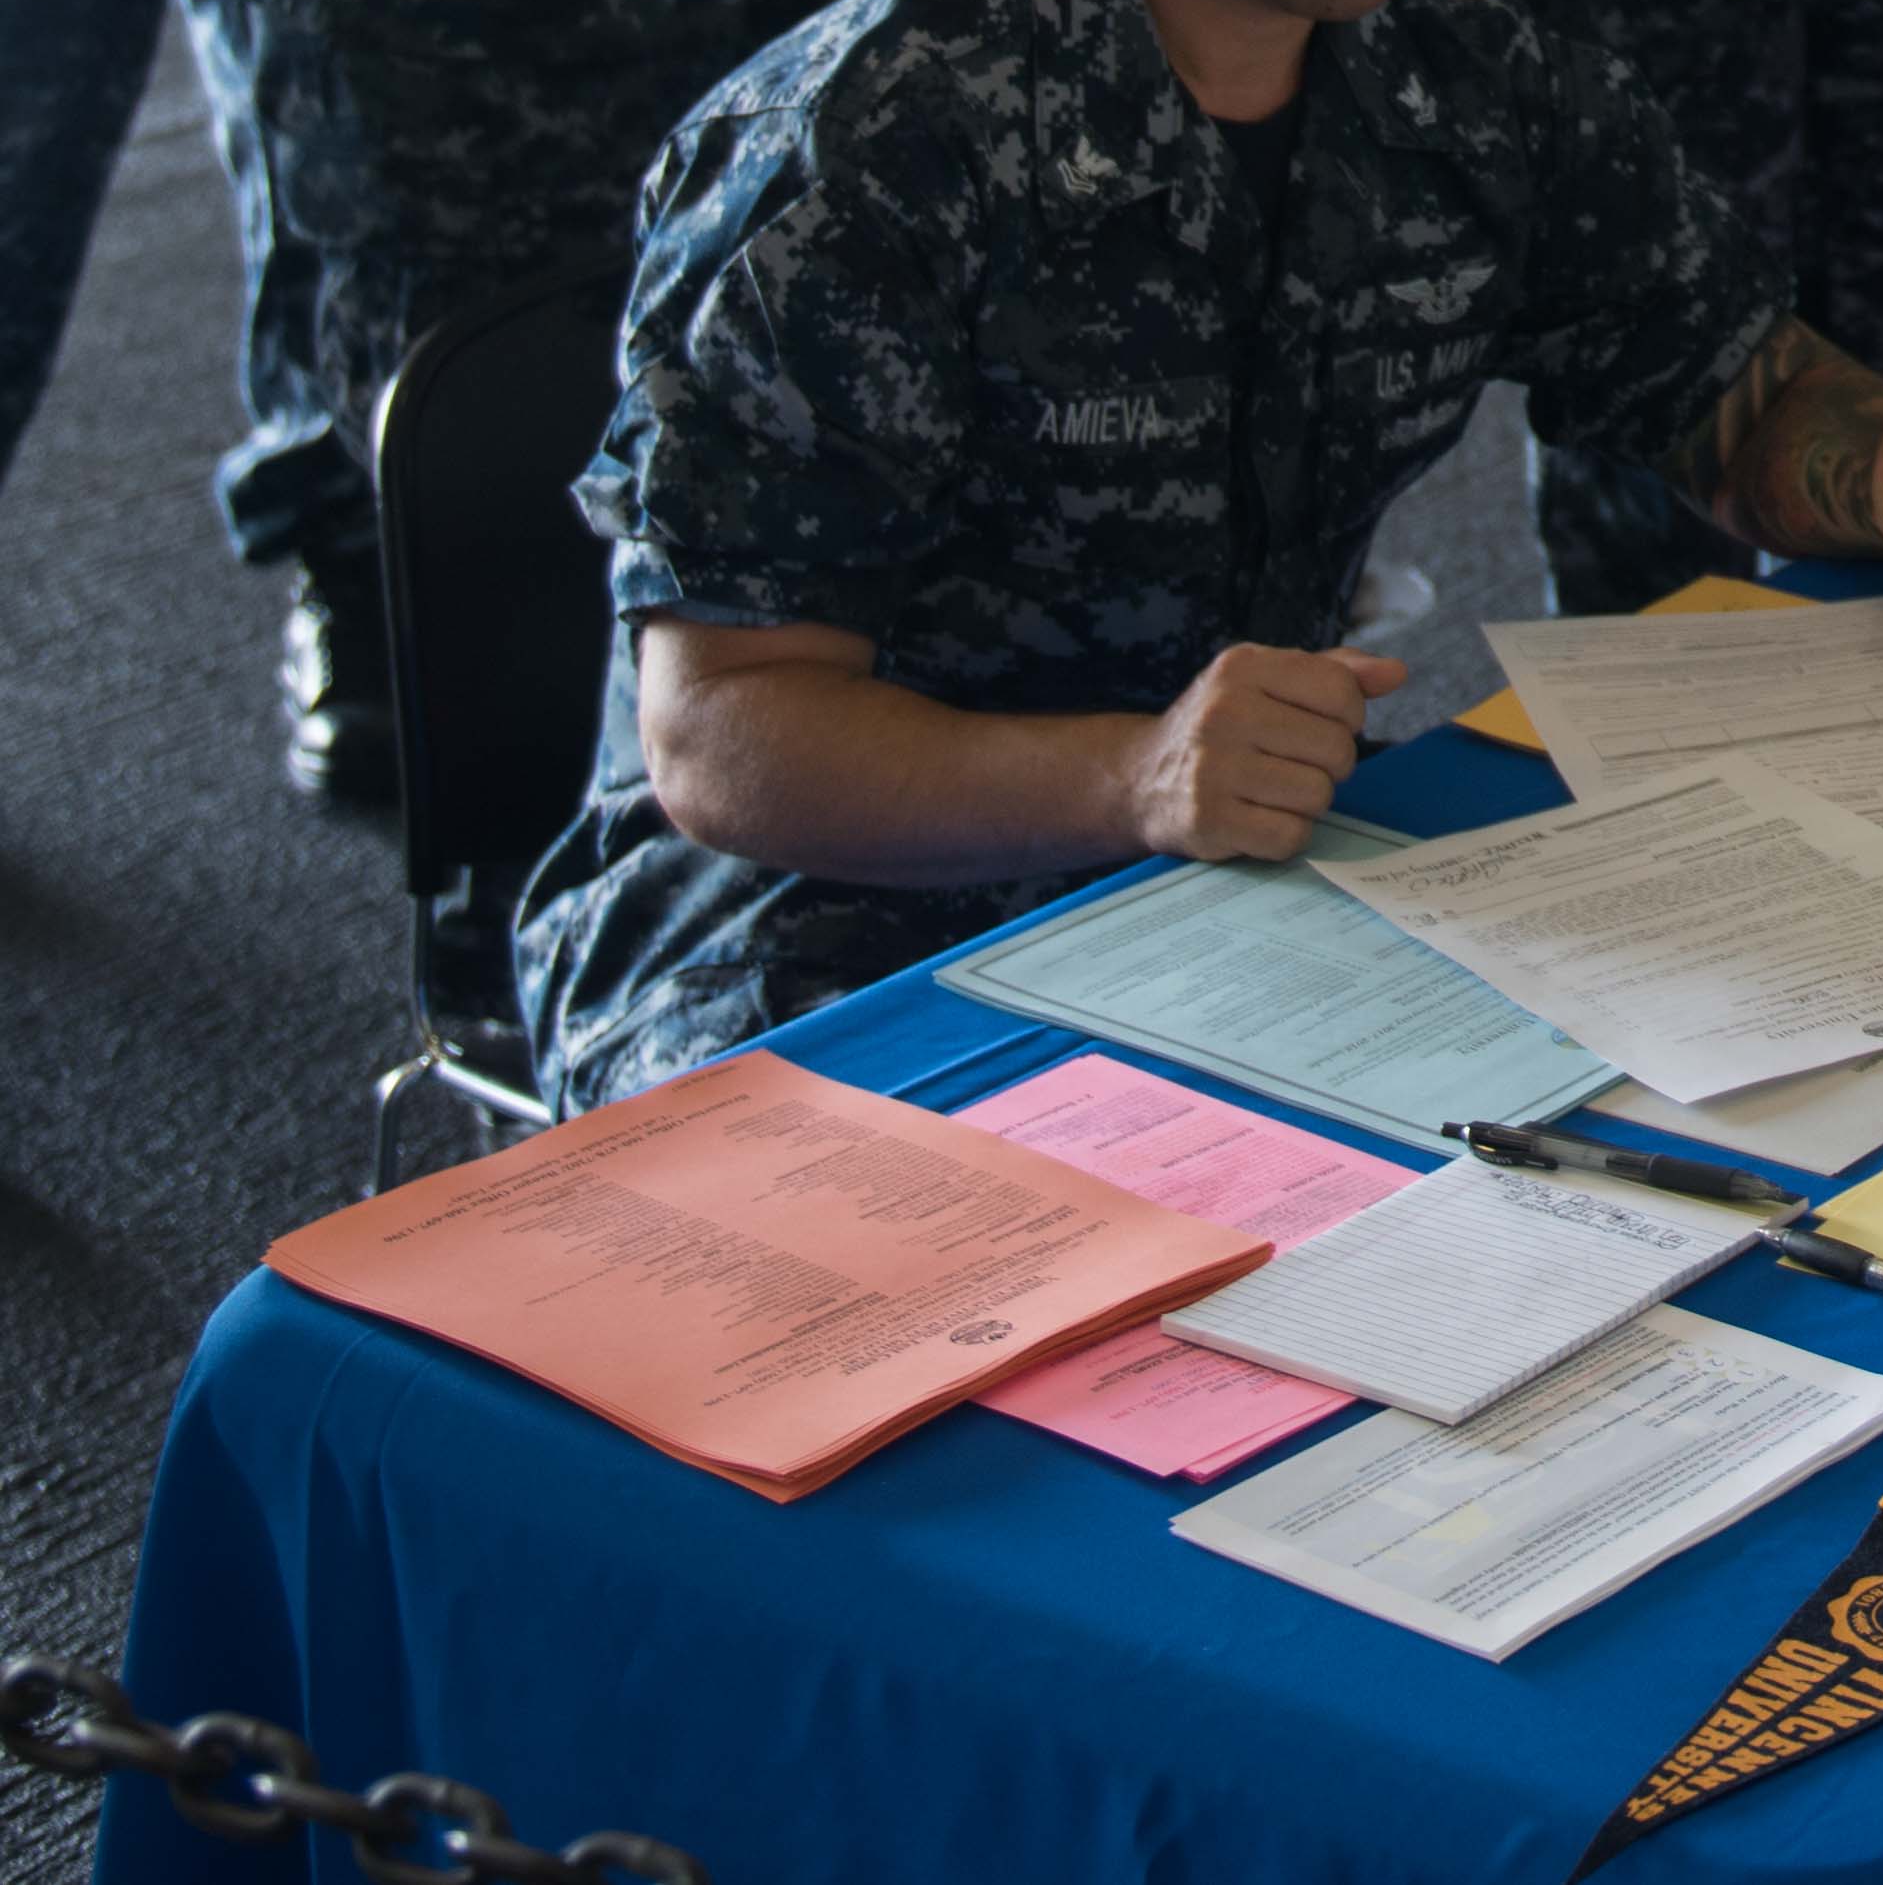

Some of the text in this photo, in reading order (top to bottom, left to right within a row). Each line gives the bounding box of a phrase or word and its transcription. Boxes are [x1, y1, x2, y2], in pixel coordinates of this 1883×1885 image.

[1375, 332, 1494, 400] U.S. NAVY
[1034, 395, 1161, 447] AMIEVA
[1452, 1013, 1538, 1060] University
[1759, 1007, 1863, 1046] University
[1626, 1637, 1851, 1816] UNIVERSITY
